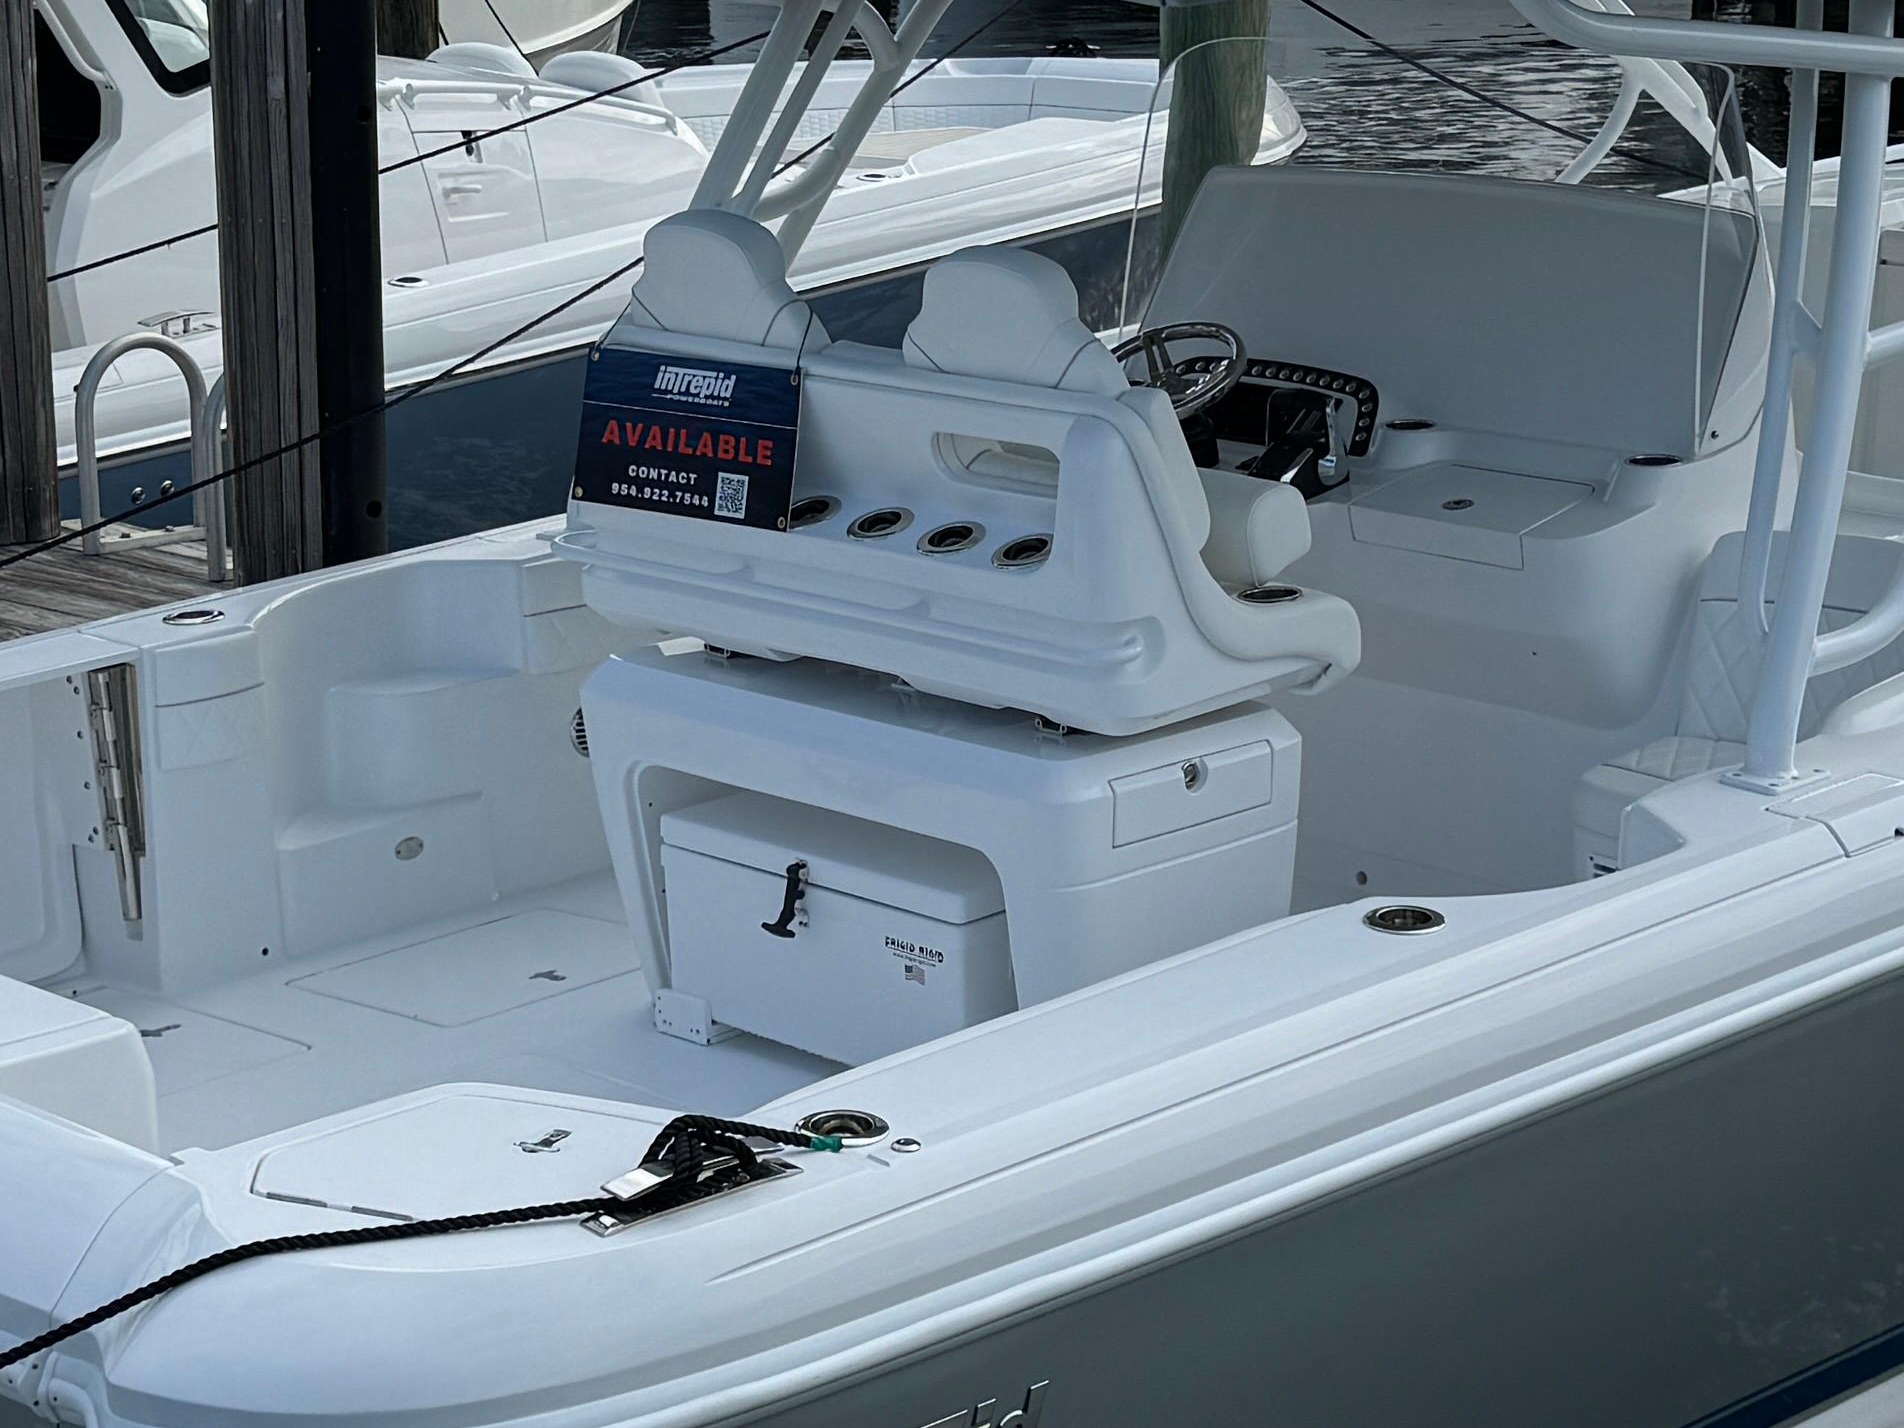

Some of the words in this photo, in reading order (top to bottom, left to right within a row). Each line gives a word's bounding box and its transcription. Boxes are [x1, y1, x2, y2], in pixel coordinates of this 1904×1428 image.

[601, 419, 774, 466] AVAILABLE
[628, 464, 698, 485] CONTACT
[611, 482, 709, 508] 954.922.7544
